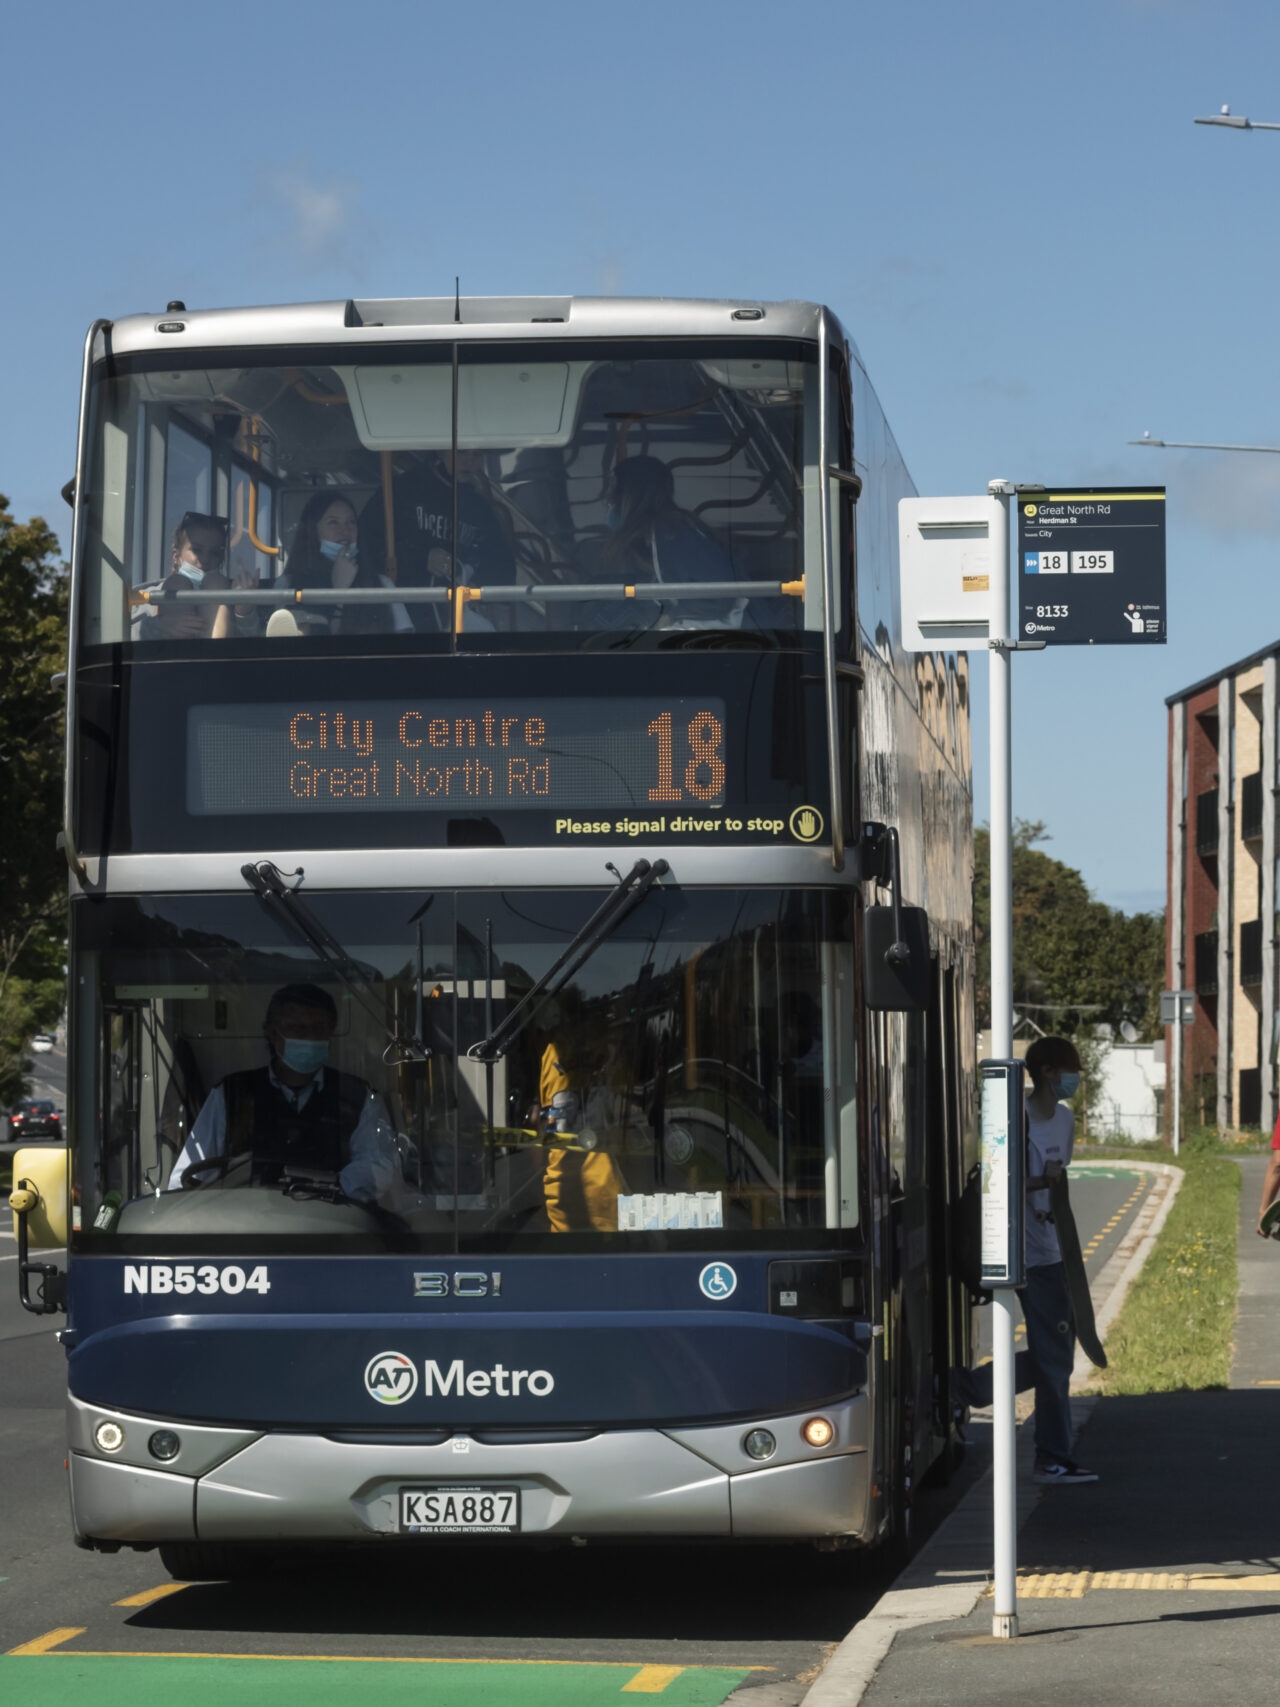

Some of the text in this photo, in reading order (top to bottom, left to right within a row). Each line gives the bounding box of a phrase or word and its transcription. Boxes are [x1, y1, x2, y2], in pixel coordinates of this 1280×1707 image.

[1038, 504, 1111, 515] Great North Rd
[1039, 530, 1053, 538] City
[1042, 556, 1061, 569] 18
[1078, 555, 1107, 569] 195
[1036, 605, 1069, 618] 8133
[289, 710, 547, 756] City Centre
[647, 711, 727, 802] 18
[289, 757, 550, 798] Great North Rd
[556, 816, 785, 837] Please signal driver to stop
[123, 1265, 271, 1295] NB5304
[413, 1271, 502, 1297] BCI
[424, 1359, 555, 1397] Metro
[406, 1496, 513, 1523] KSA887
